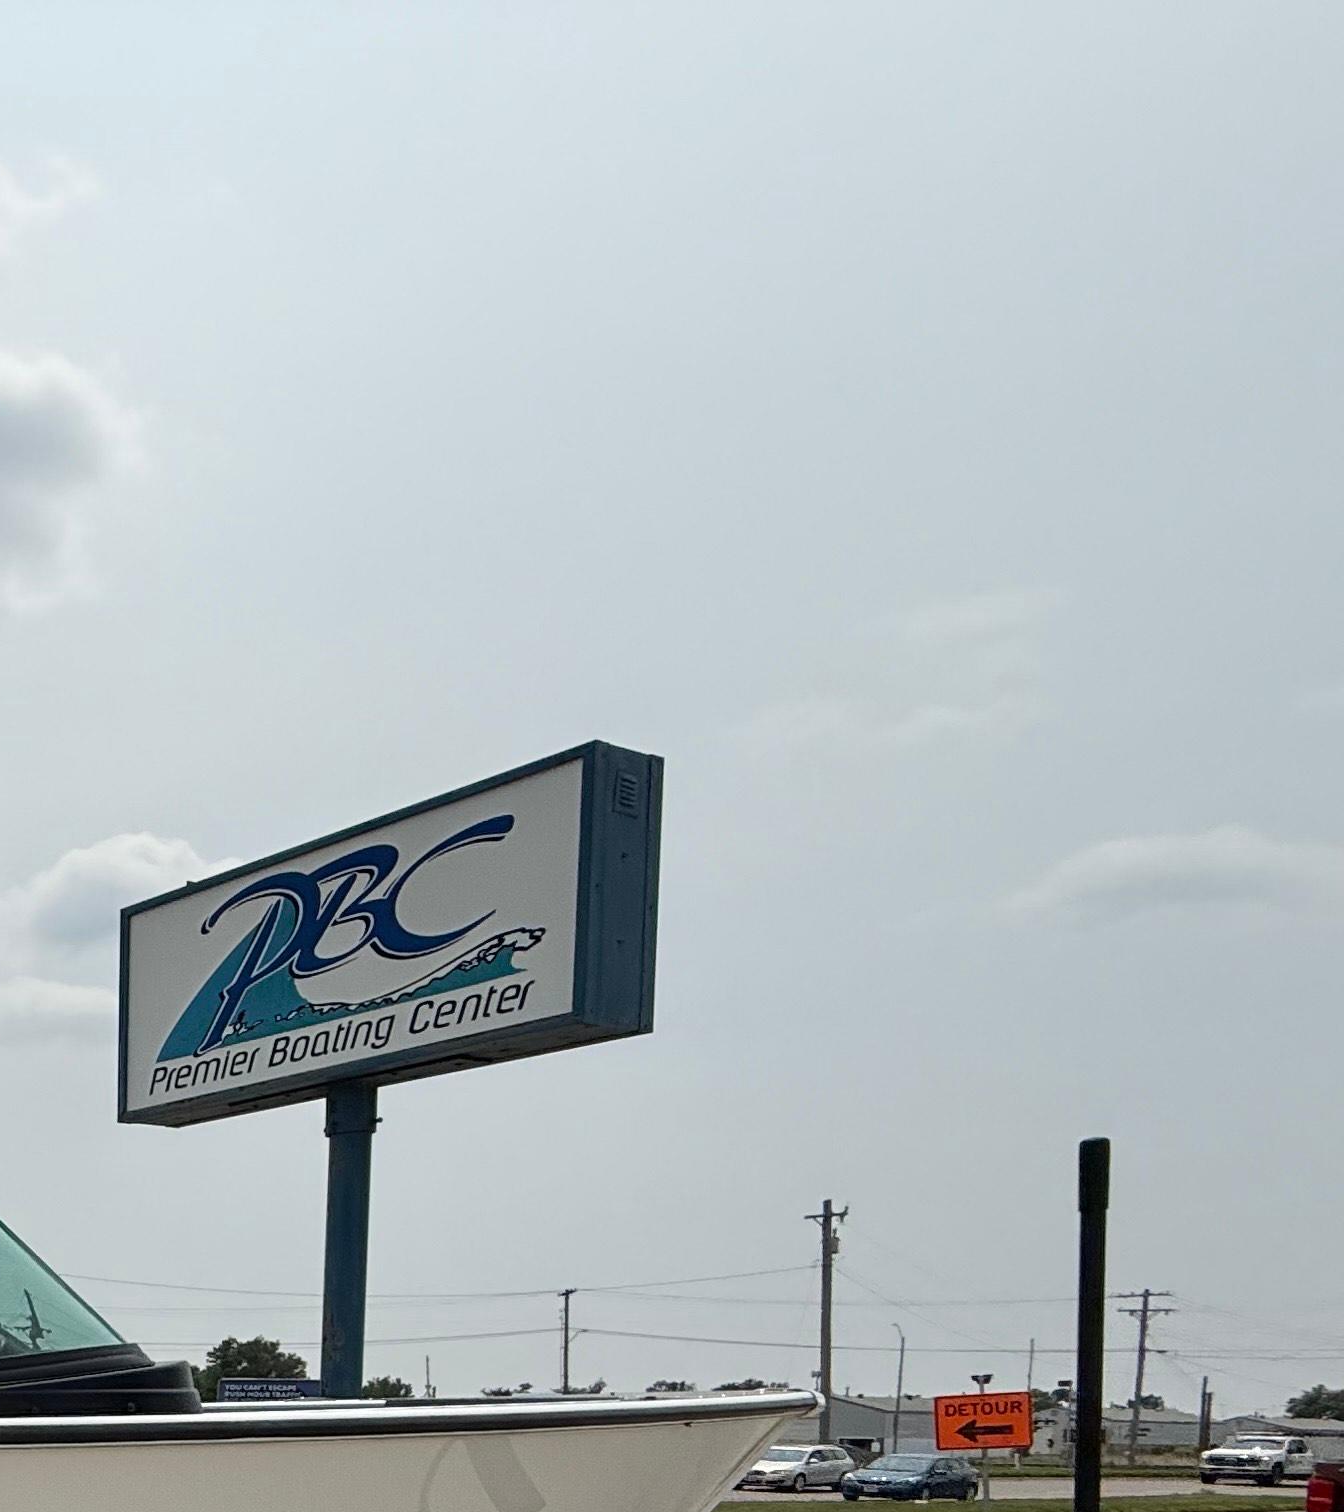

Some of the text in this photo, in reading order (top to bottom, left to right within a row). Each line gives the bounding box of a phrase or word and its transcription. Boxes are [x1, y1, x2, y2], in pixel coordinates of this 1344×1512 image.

[149, 980, 535, 1096] Premier Boating Center
[944, 1400, 1023, 1417] DETOUR
